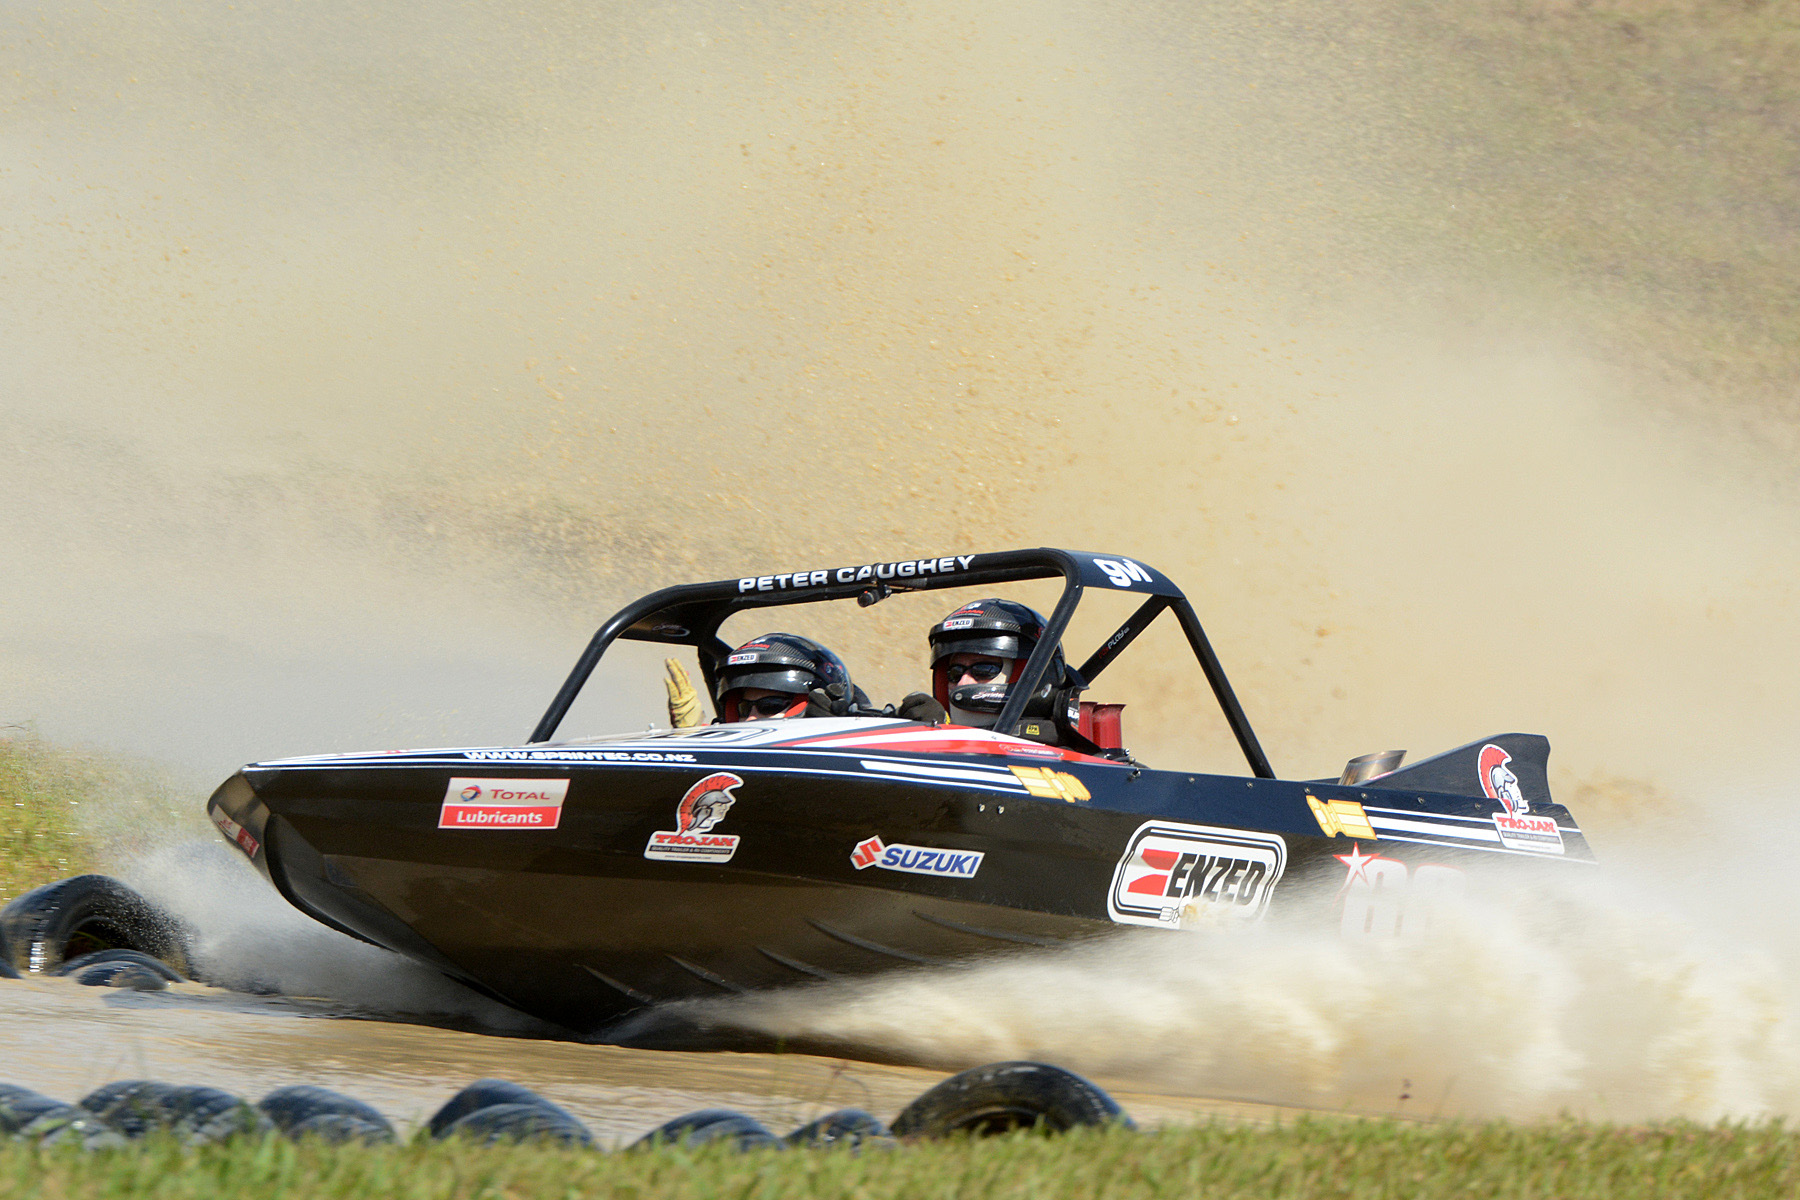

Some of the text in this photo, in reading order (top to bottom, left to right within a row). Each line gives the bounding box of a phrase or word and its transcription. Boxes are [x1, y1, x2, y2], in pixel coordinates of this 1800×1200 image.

[738, 554, 976, 593] PETER CAUGHEY
[464, 751, 697, 763] WWW.SPRINTEC.CO.NZ
[456, 810, 543, 825] Lubricants
[1496, 816, 1556, 833] TROJAN
[655, 834, 736, 847] TROJAN
[881, 847, 980, 875] SUZUKI
[1165, 852, 1267, 906] ENZED
